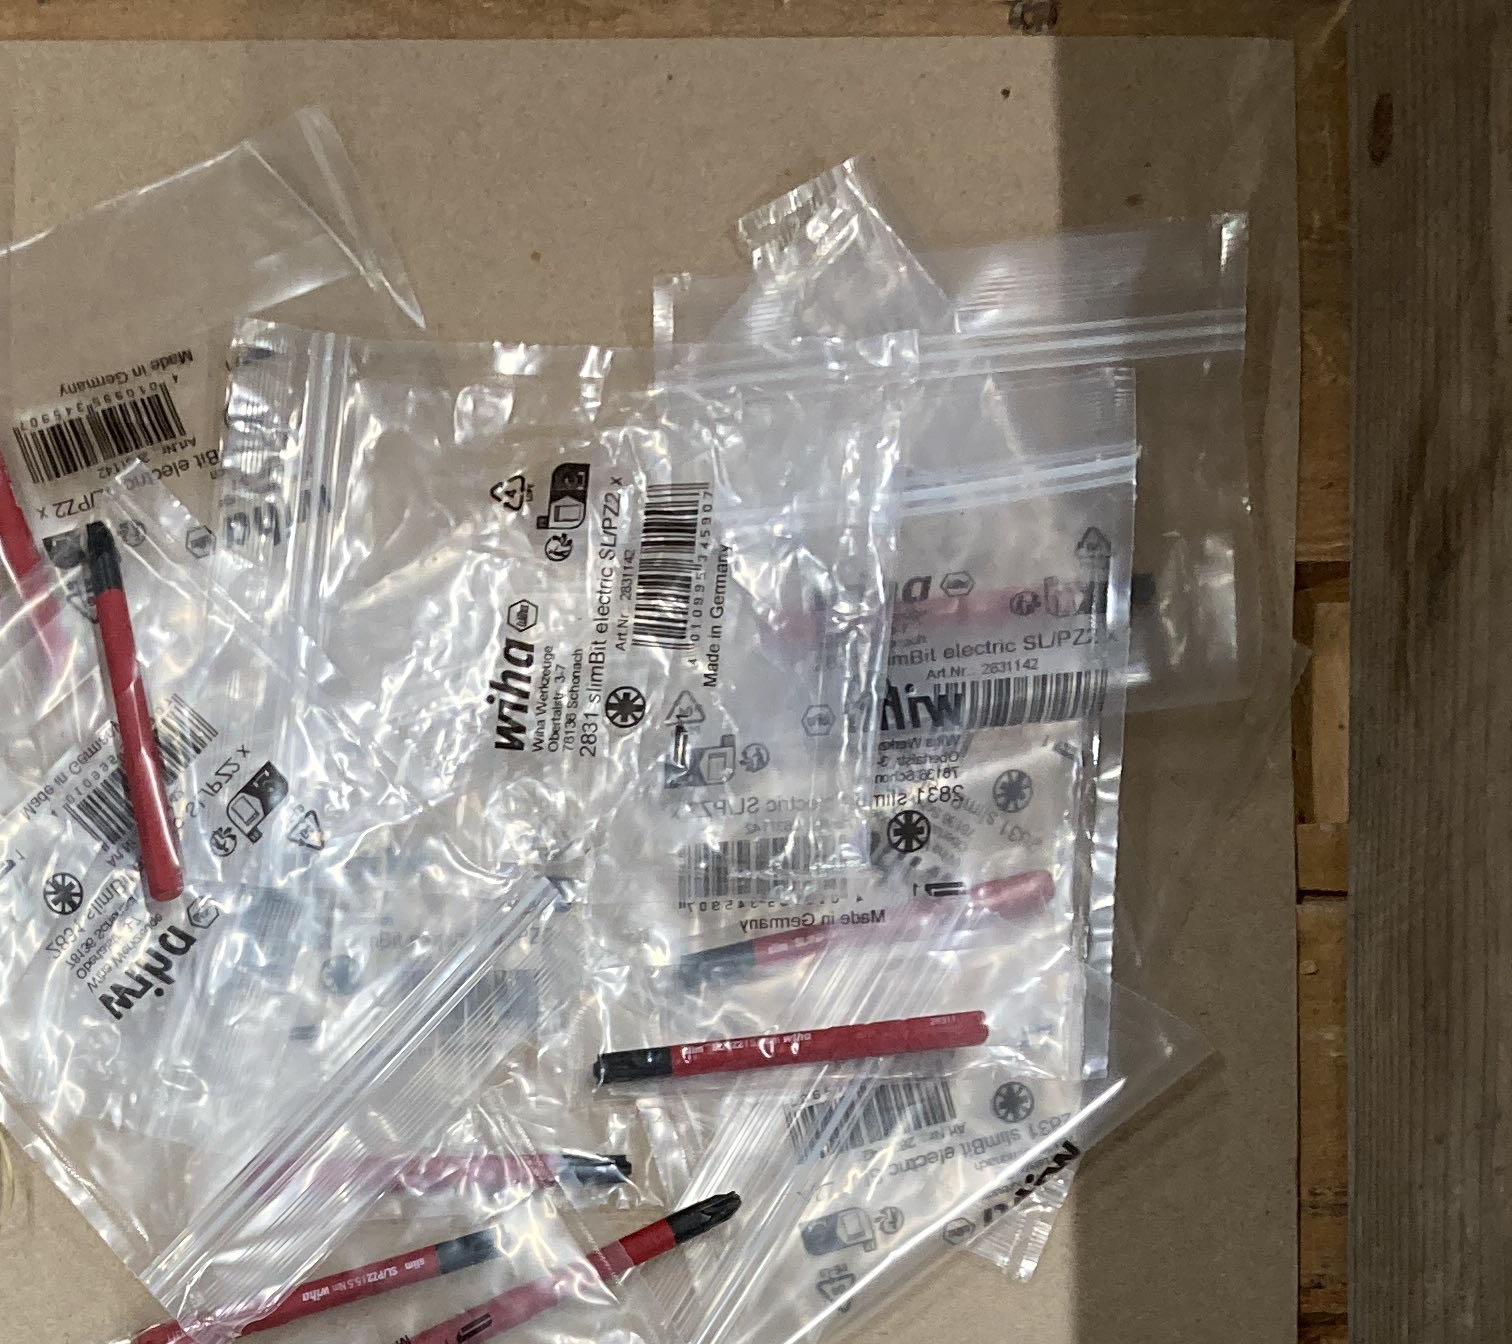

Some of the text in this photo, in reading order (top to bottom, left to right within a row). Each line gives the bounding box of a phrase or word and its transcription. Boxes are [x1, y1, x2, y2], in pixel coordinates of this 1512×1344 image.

[57, 347, 193, 401] Made in Germany
[619, 548, 636, 600] 2831142
[579, 475, 622, 757] 2831 slimBit electric SL/PZ2 x
[703, 544, 732, 687] Made in Germany
[554, 663, 566, 683] 3-7
[942, 636, 1016, 659] electric
[980, 657, 1039, 674] 2831142
[481, 636, 535, 750] wiha
[532, 645, 555, 752] Wiha Werkzeuge
[562, 647, 583, 751] 78136 Schonach
[301, 1285, 330, 1303] wiha
